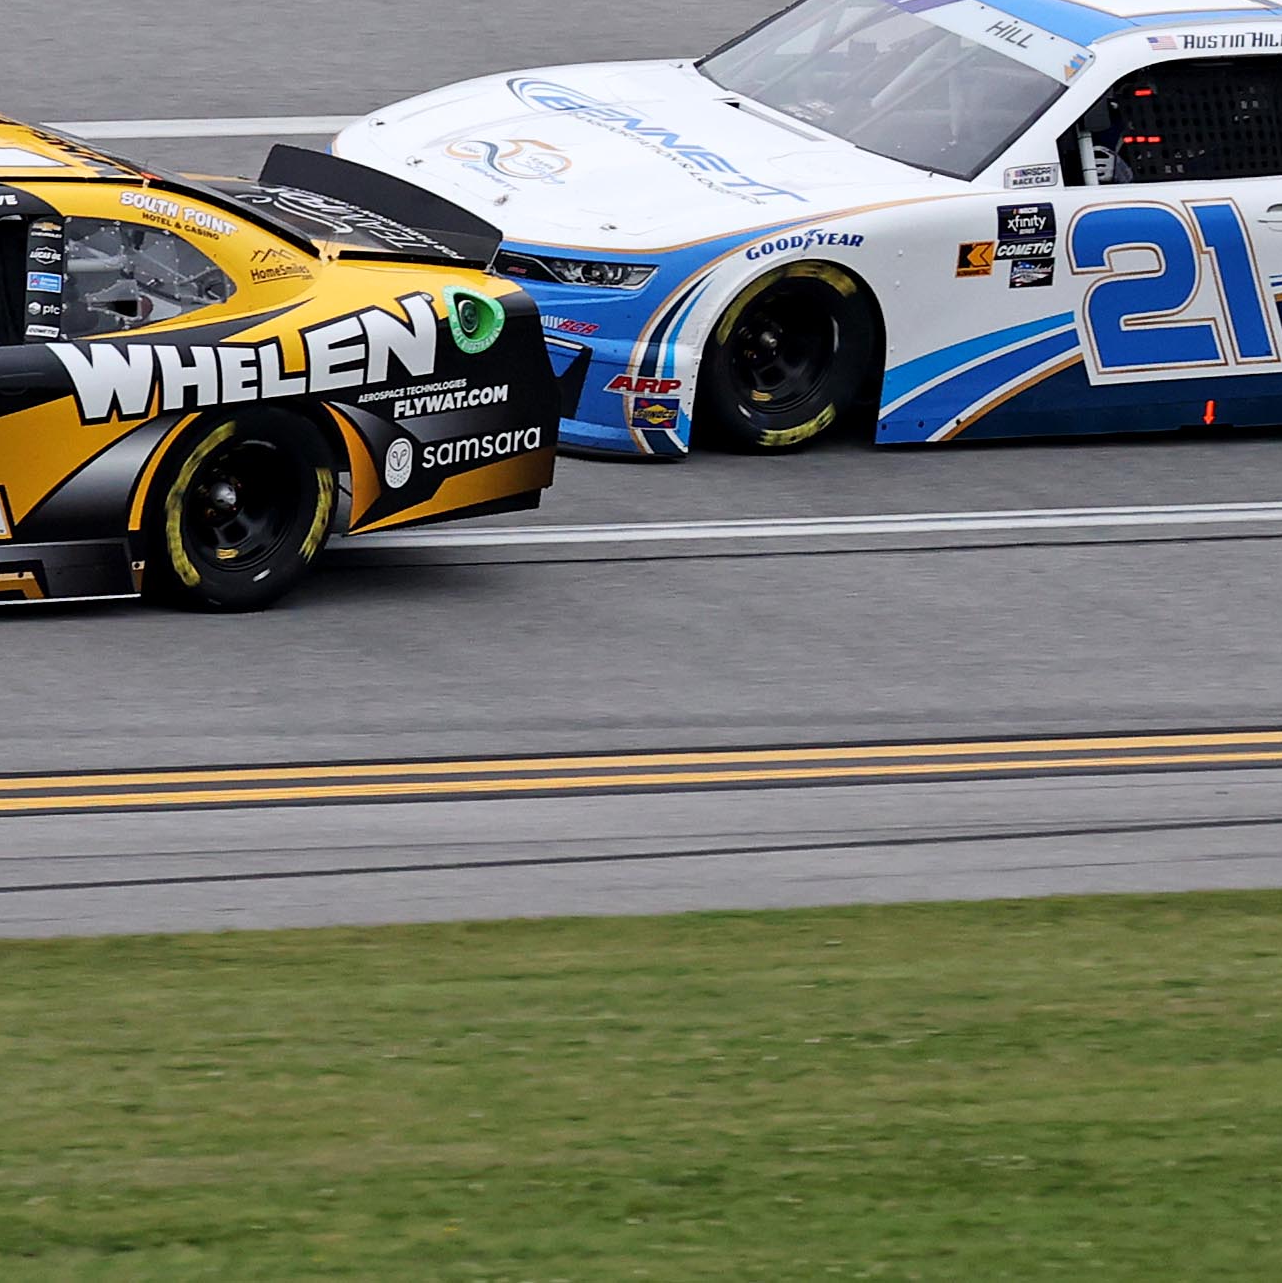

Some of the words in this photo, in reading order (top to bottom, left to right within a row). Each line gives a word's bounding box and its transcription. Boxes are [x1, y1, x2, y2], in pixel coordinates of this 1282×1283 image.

[985, 20, 1034, 49] HILL
[1177, 34, 1244, 49] AUSTIN
[527, 95, 810, 203] BENNETT
[1012, 177, 1033, 186] RACE
[1035, 176, 1051, 184] CAR
[120, 191, 179, 218] SOUTH
[183, 206, 238, 236] POINT
[142, 212, 172, 227] HOTEL
[184, 226, 220, 241] CASINO
[1007, 215, 1047, 231] xfinity
[29, 251, 51, 259] LUCAS
[745, 229, 864, 261] GOODYEAR
[997, 239, 1054, 256] COMETIC
[250, 263, 310, 281] HomeSmiles
[1069, 199, 1277, 373] 21
[46, 294, 437, 420] WHELEN
[357, 386, 405, 403] AEROSPACE
[406, 378, 467, 395] TECHNOLOGIES
[609, 375, 682, 394] ARP
[393, 384, 508, 418] FLYWAT.COM
[421, 426, 541, 468] samsara
